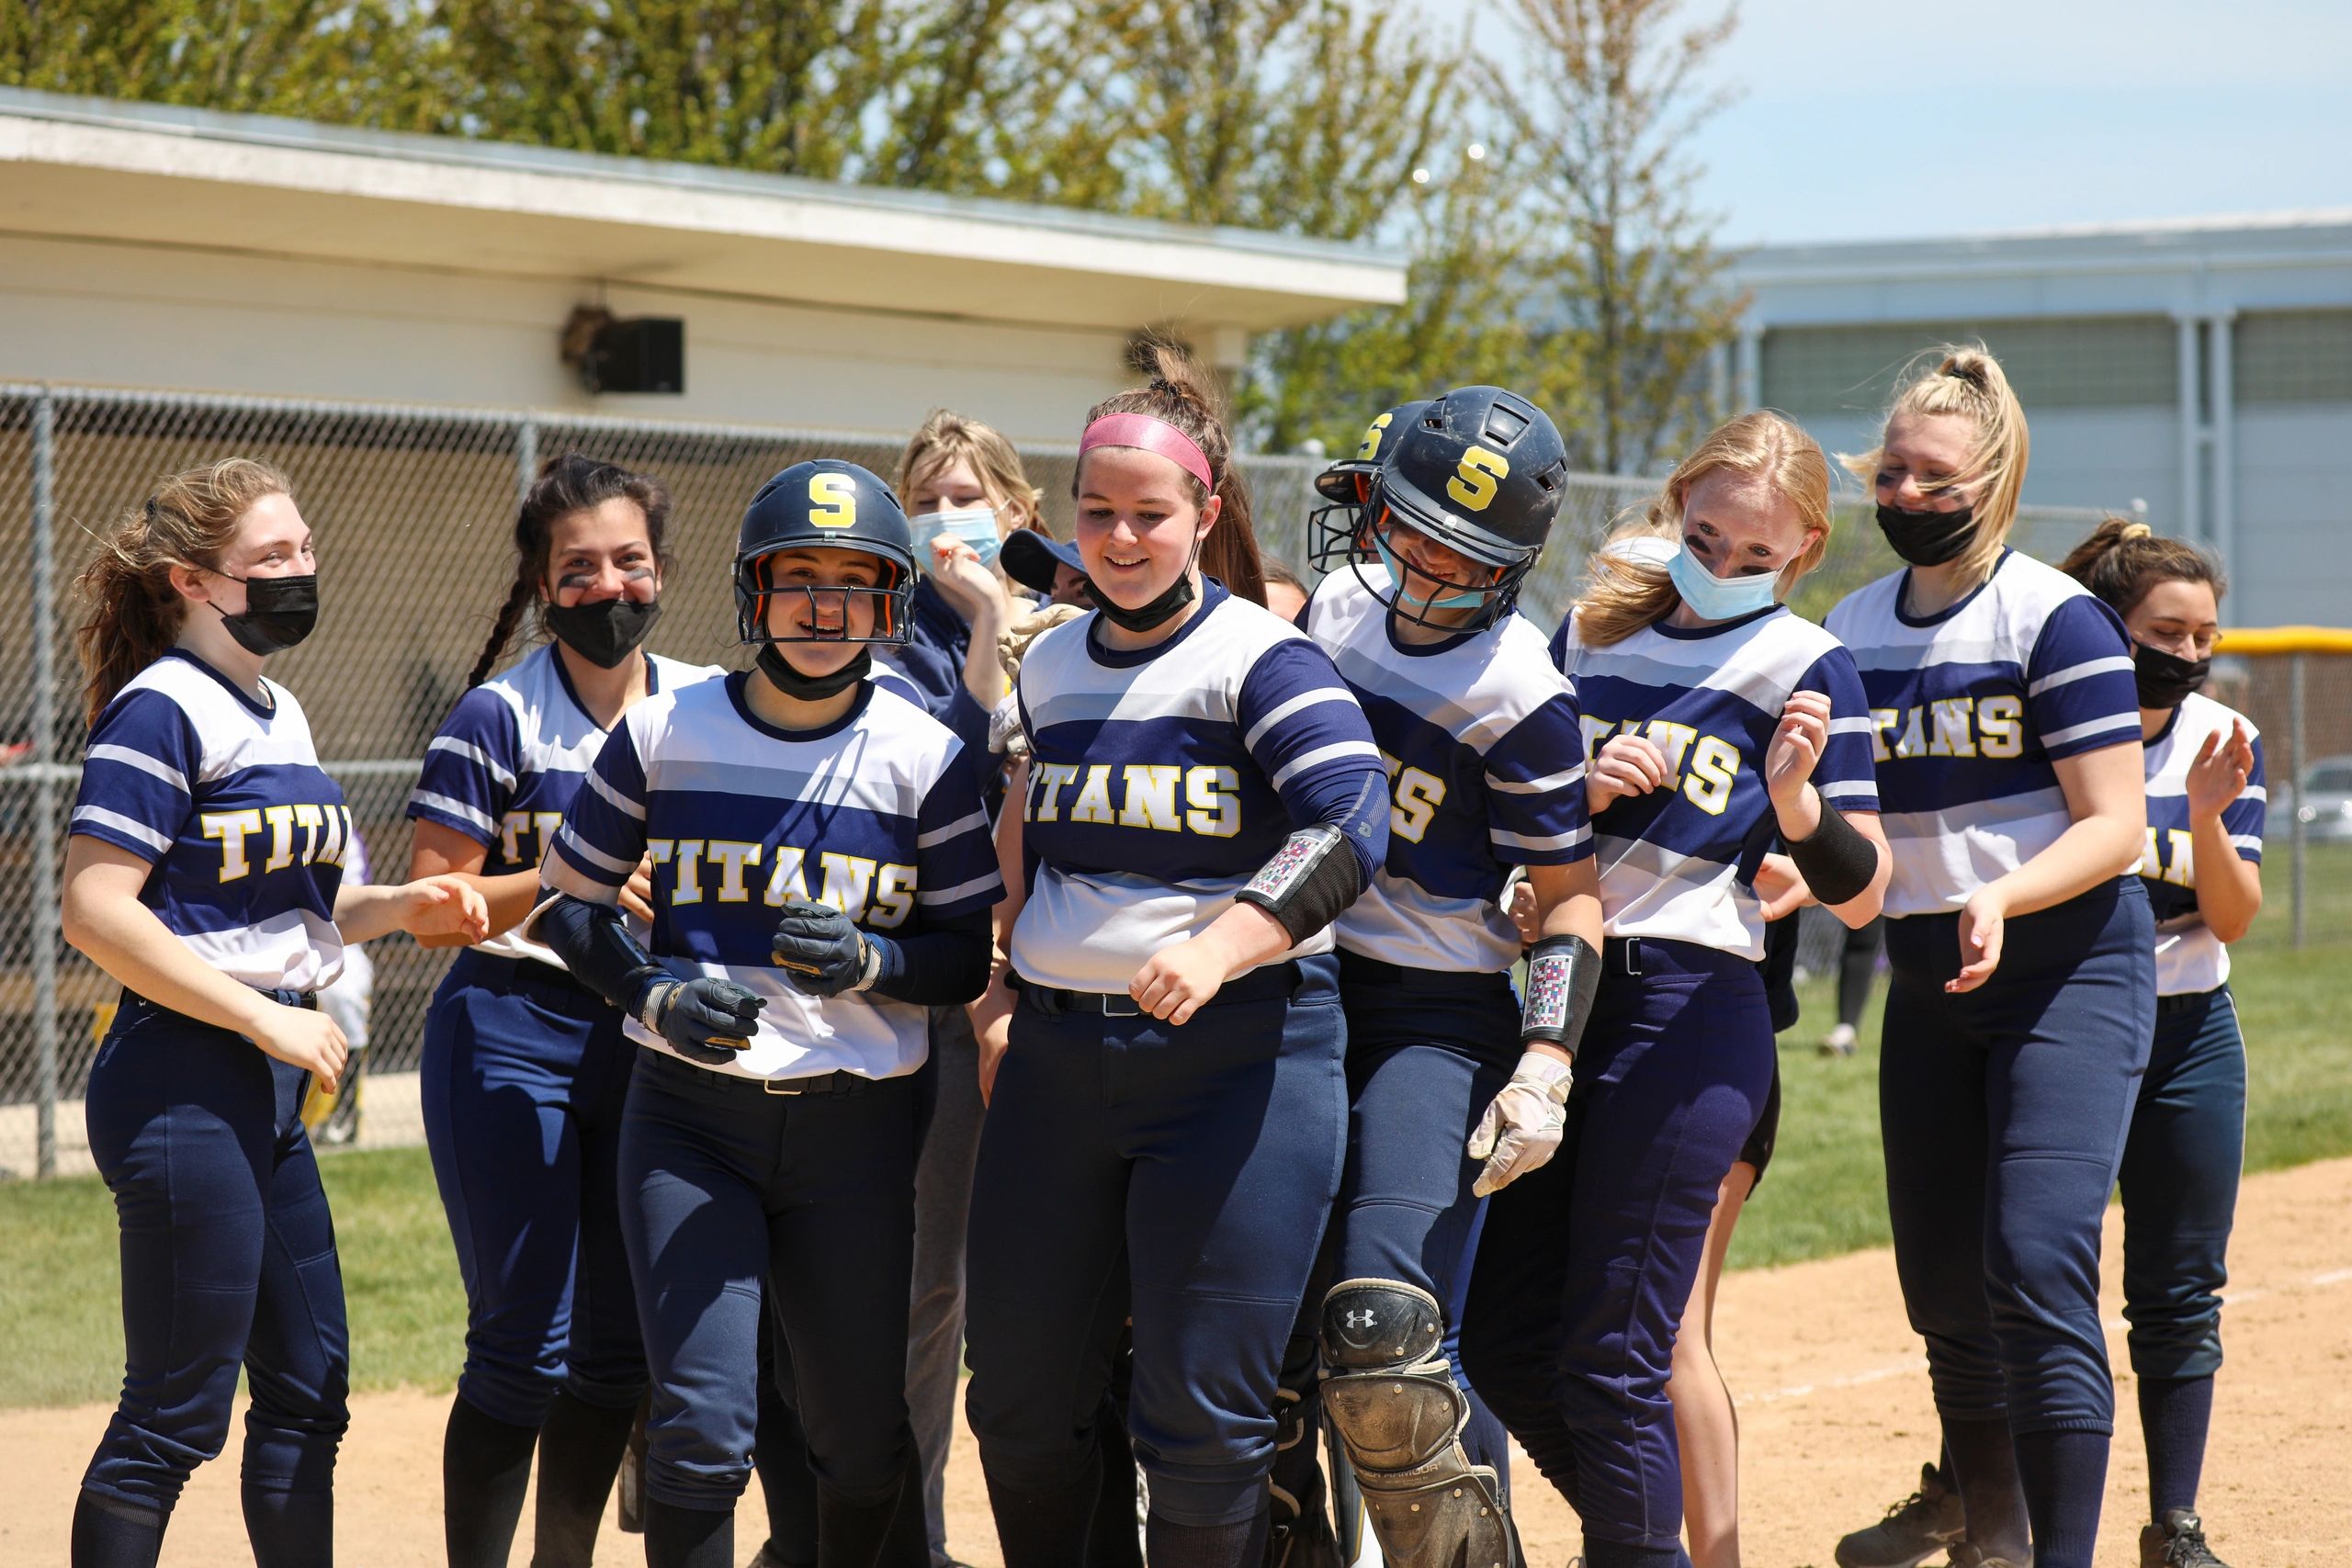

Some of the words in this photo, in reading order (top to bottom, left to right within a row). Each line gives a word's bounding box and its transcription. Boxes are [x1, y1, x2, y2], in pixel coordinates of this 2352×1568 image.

[808, 472, 856, 528] S
[1446, 446, 1510, 512] S
[1579, 714, 1742, 816] TNS
